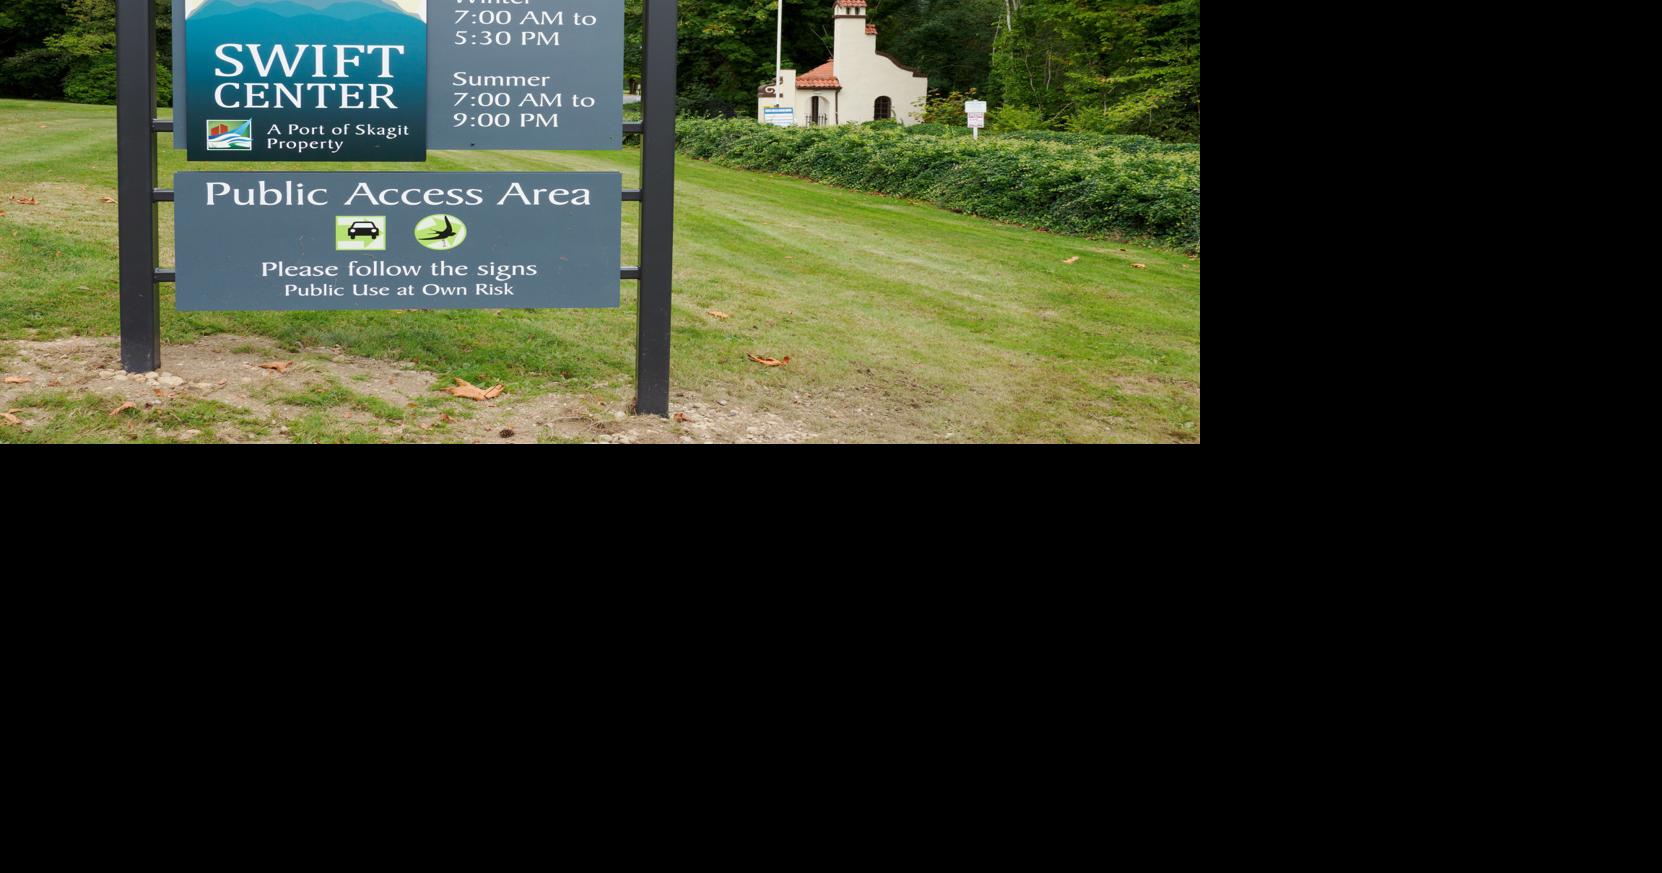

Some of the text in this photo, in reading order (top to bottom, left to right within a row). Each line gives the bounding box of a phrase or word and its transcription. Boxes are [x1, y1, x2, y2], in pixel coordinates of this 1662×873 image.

[455, 9, 597, 26] 7:00 AM to
[454, 30, 560, 46] 5:30 PM
[214, 43, 405, 78] SWIFT
[452, 71, 551, 87] Summer
[214, 82, 398, 109] CENTER
[454, 92, 595, 108] 7:00 AM to
[453, 112, 558, 128] 9:00 PM
[266, 123, 409, 140] A Port of Skagit
[267, 137, 344, 154] Property
[206, 180, 591, 206] Public Access Area
[261, 260, 538, 282] Please follow the signs
[285, 282, 514, 297] Public Use at Own Risk
